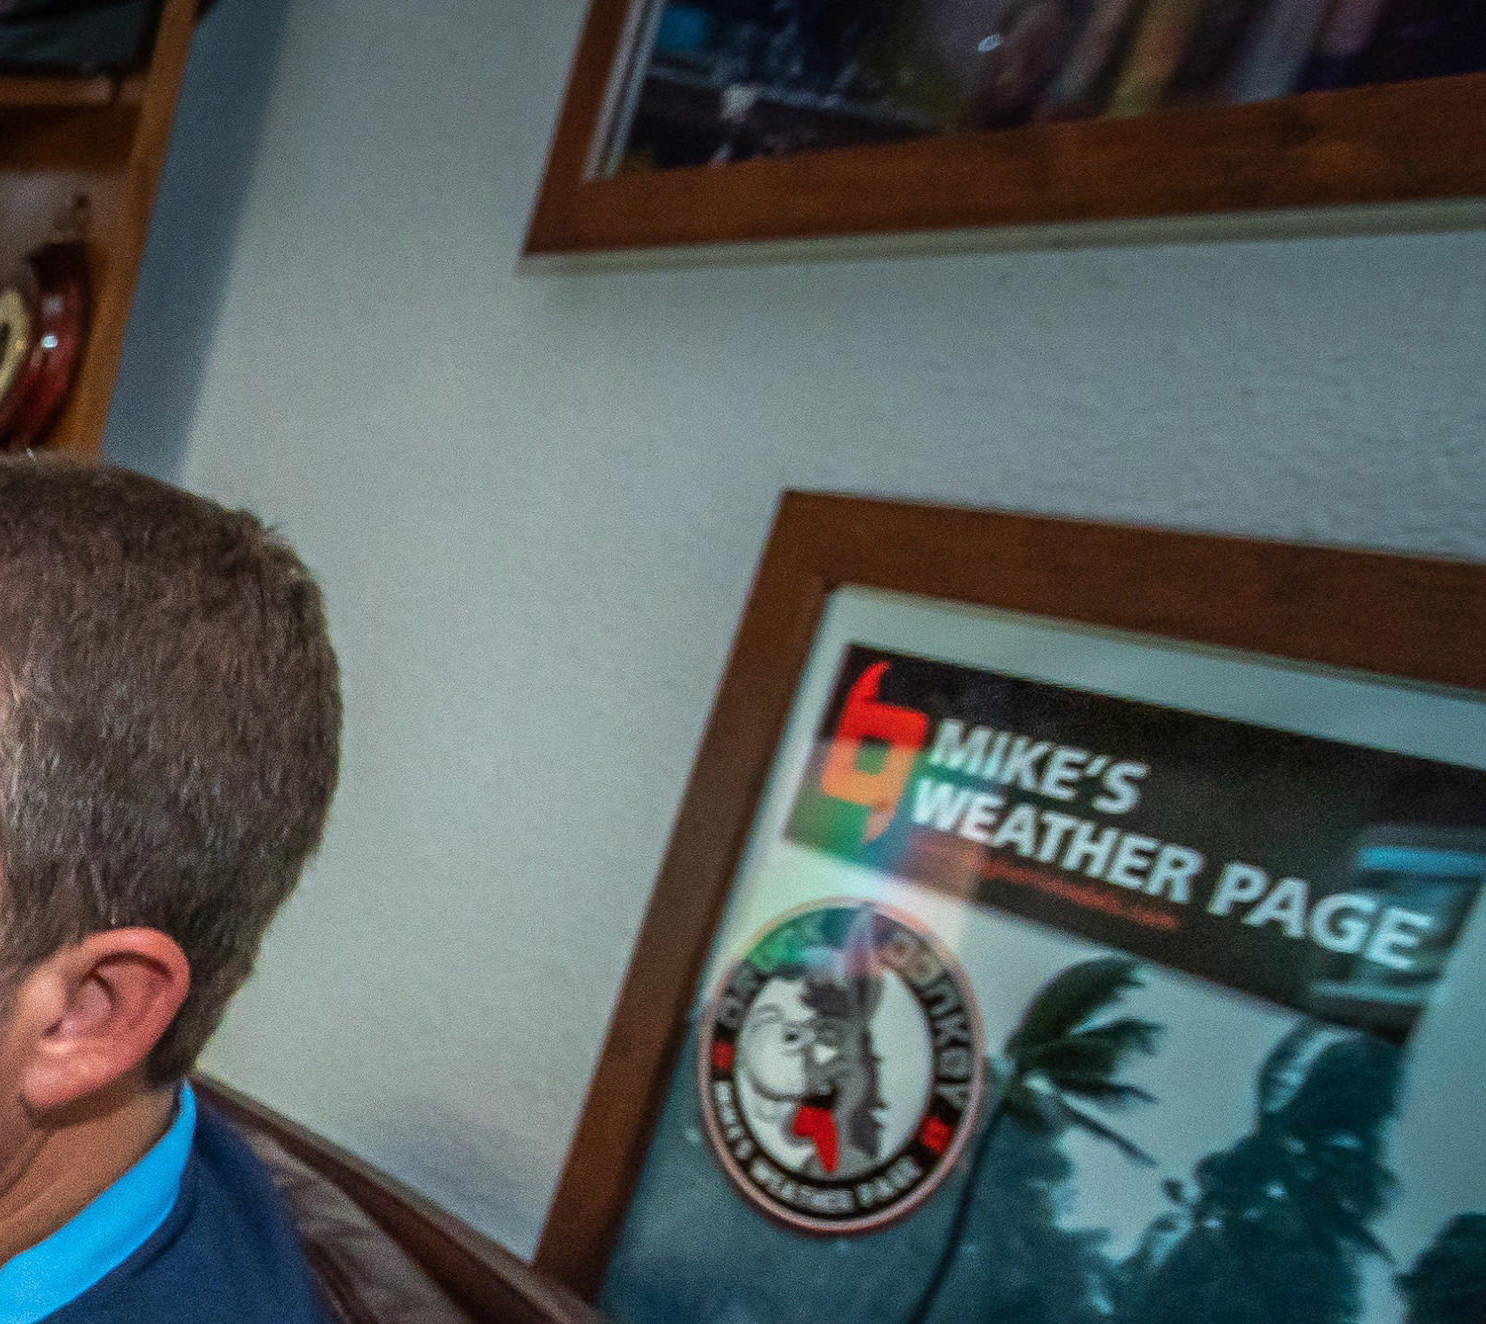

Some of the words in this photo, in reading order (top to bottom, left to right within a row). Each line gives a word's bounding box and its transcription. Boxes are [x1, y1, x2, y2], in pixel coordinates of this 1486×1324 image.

[930, 718, 1151, 815] MIKE'S
[912, 778, 1205, 906] WEATHER
[1206, 861, 1432, 972] PAGE
